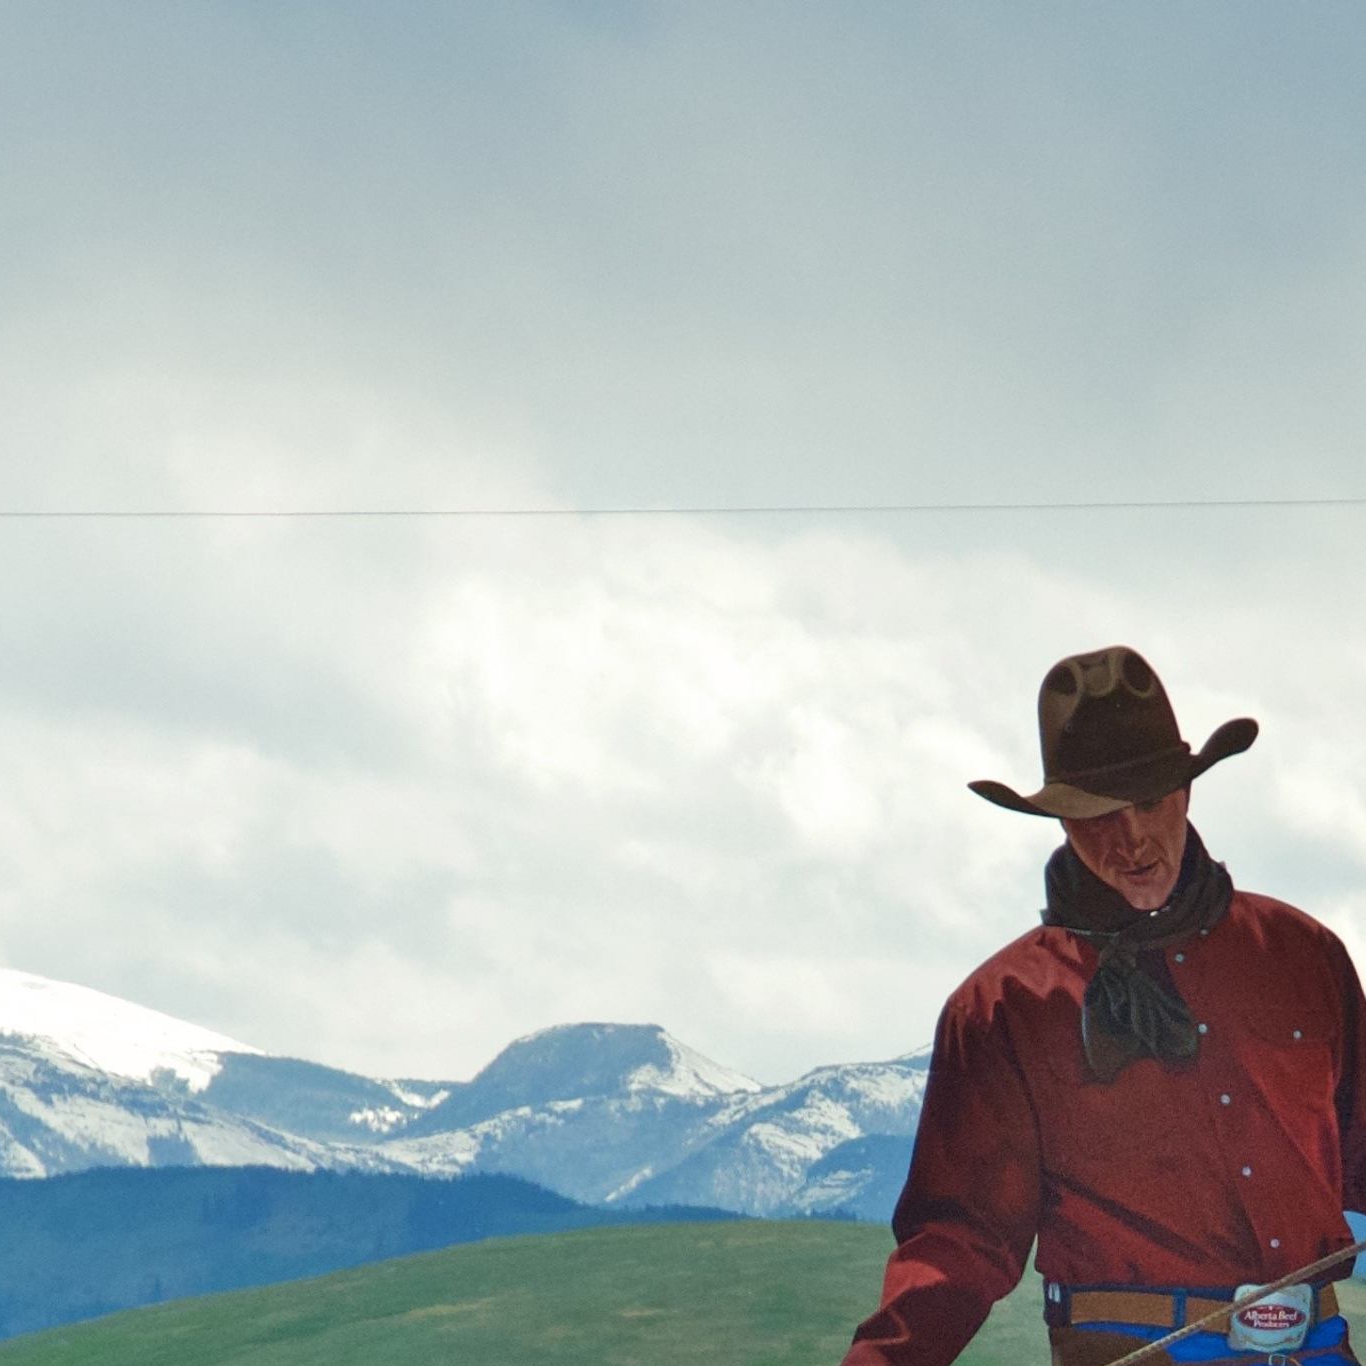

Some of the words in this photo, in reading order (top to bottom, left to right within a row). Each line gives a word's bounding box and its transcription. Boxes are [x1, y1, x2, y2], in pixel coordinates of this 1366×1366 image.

[1244, 1310, 1277, 1321] Alberta
[1278, 1310, 1298, 1321] Beef
[1253, 1320, 1290, 1328] Producers
